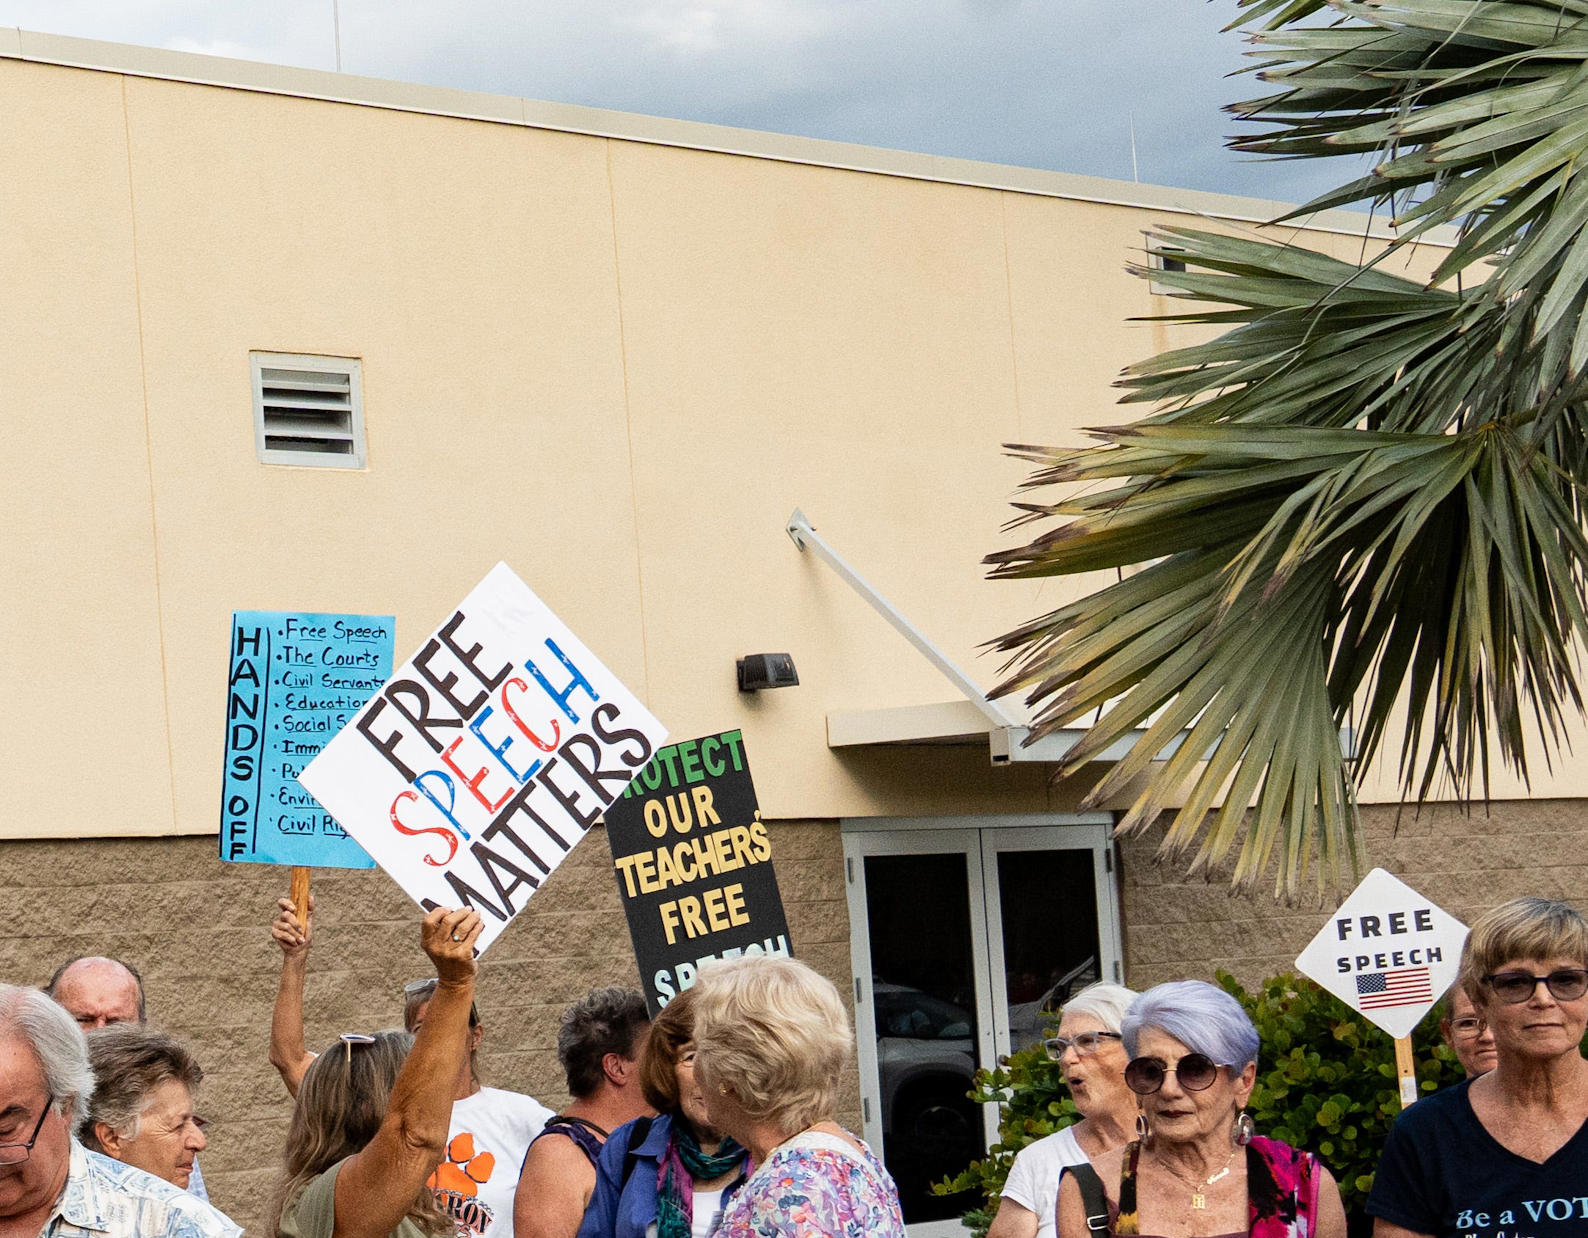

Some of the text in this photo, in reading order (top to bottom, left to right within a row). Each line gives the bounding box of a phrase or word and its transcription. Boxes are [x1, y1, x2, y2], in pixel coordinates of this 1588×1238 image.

[286, 618, 388, 644] Free Speech
[282, 645, 380, 667] The Courts
[281, 671, 314, 688] Civil
[356, 611, 514, 783] FREE
[283, 714, 332, 733] Social
[228, 626, 261, 861] HANDS OFF
[389, 637, 600, 867] SPEECH
[277, 814, 316, 833] Civil
[643, 785, 722, 839] OUR
[659, 883, 750, 946] FREE
[1337, 909, 1434, 941] FREE
[1337, 946, 1443, 974] SPEECH
[1456, 1209, 1491, 1230] Be
[1499, 1209, 1516, 1225] a
